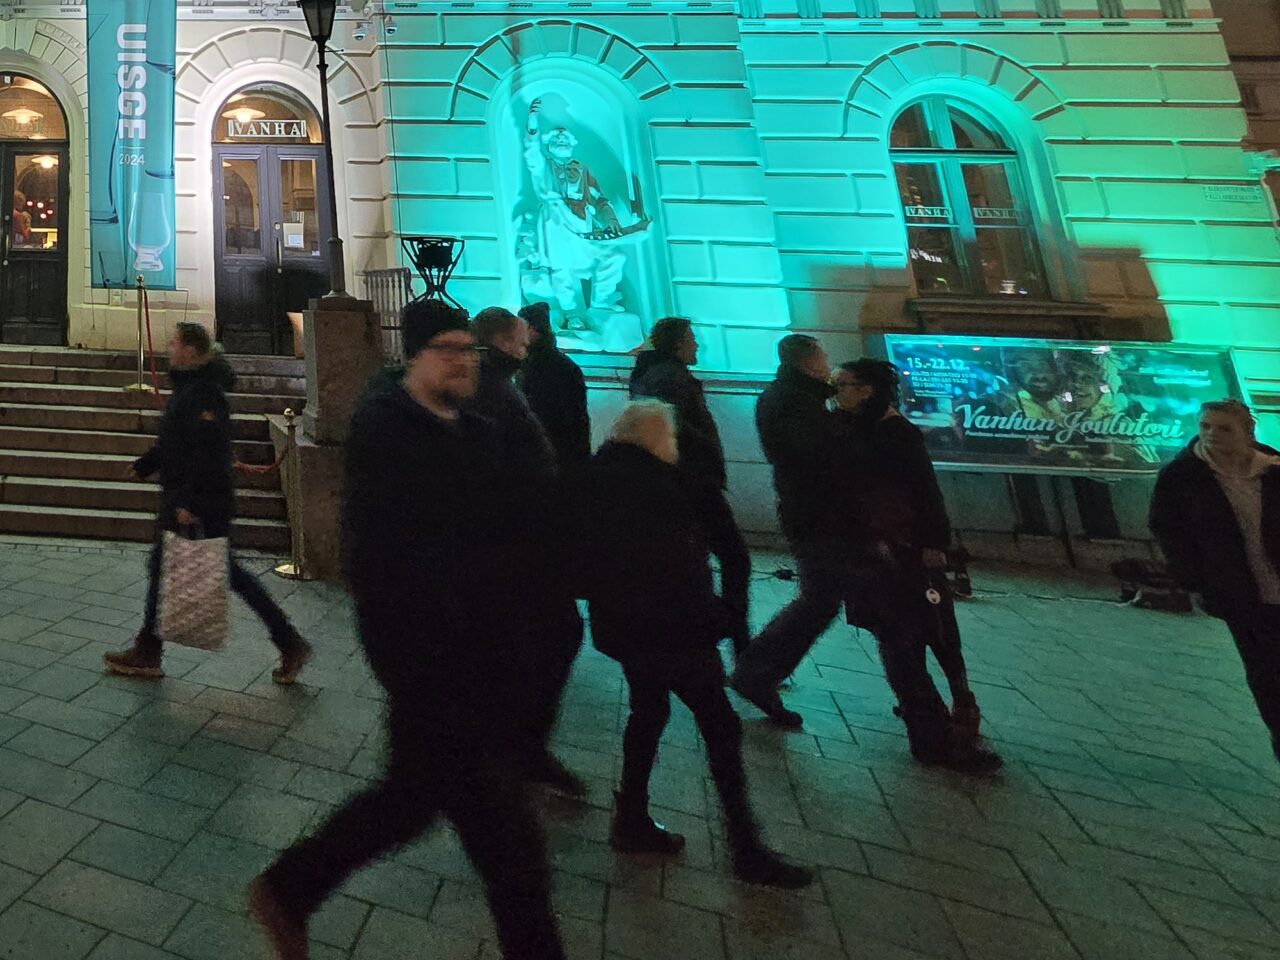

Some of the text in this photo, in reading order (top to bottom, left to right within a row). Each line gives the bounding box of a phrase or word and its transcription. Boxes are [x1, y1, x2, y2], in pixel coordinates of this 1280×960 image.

[117, 24, 147, 139] UISGE
[234, 122, 301, 136] VANHA
[119, 153, 146, 166] 2024
[909, 208, 949, 217] VANHA
[954, 404, 1184, 443] Vanhan Joulutori
